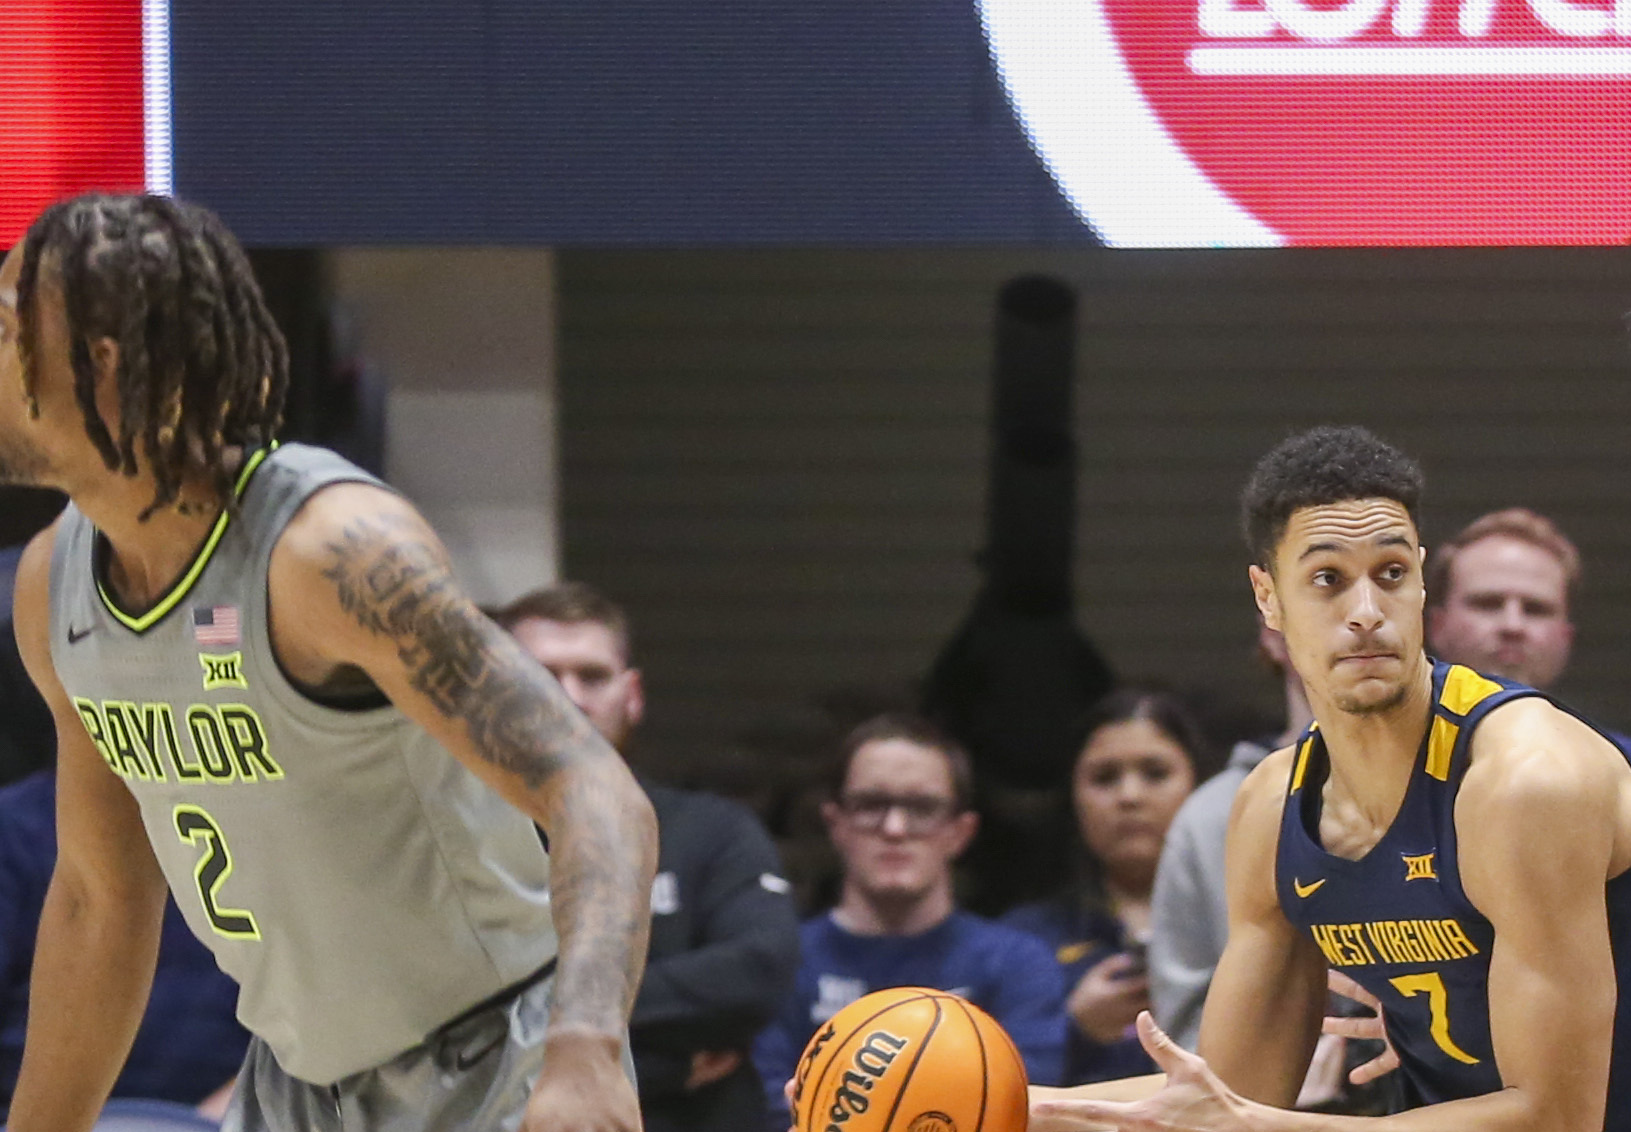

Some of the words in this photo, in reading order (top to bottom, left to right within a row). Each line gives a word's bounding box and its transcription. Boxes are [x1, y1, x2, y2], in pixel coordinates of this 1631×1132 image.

[73, 697, 285, 784] BAYLOR
[172, 803, 262, 941] 2
[1311, 922, 1376, 966] WEST
[1365, 919, 1480, 964] VIRGINIA
[1389, 972, 1480, 1064] 7
